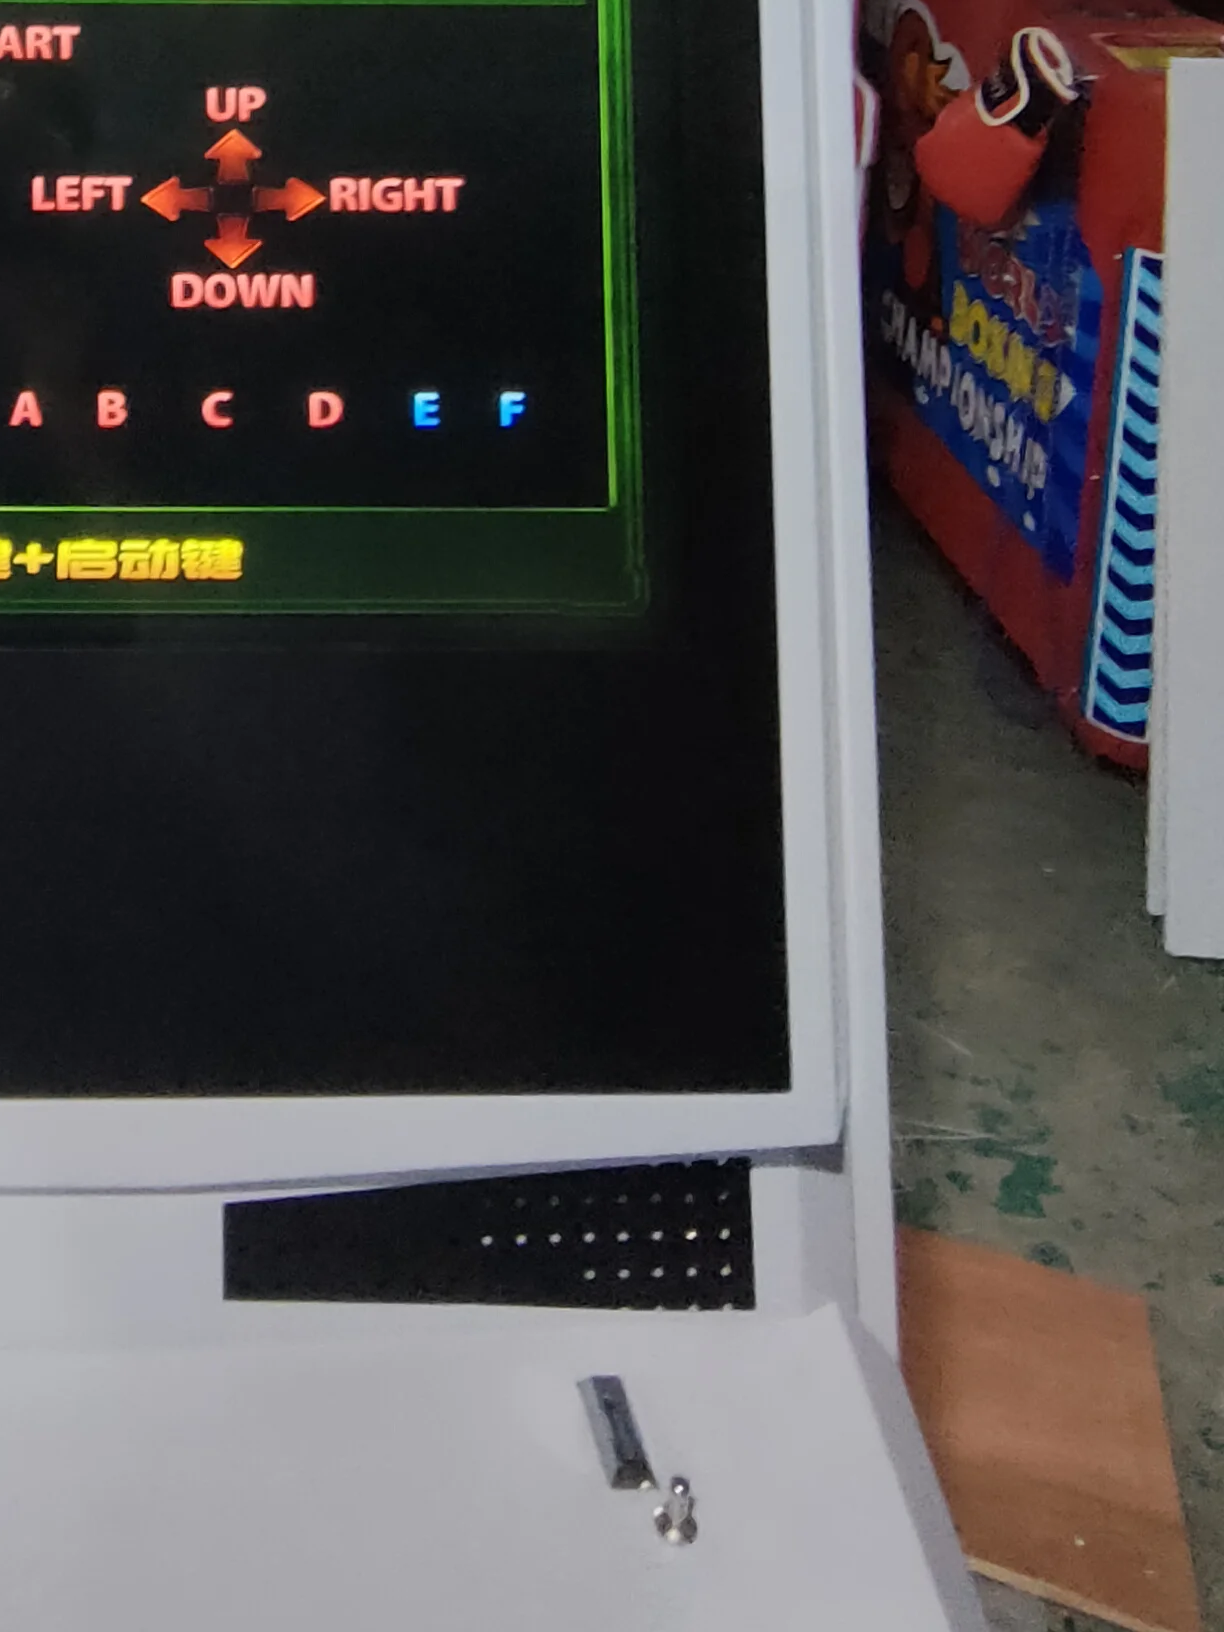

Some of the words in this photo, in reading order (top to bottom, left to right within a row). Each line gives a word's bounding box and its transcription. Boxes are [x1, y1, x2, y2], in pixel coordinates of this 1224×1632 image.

[206, 86, 267, 121] UP
[30, 175, 133, 213] LEFT
[329, 177, 465, 214] RIGHT
[170, 272, 315, 310] DOWN
[9, 390, 43, 428] A
[97, 389, 128, 428] B
[201, 391, 233, 428] C
[308, 391, 344, 428] D
[413, 391, 441, 428] E
[500, 392, 526, 428] F
